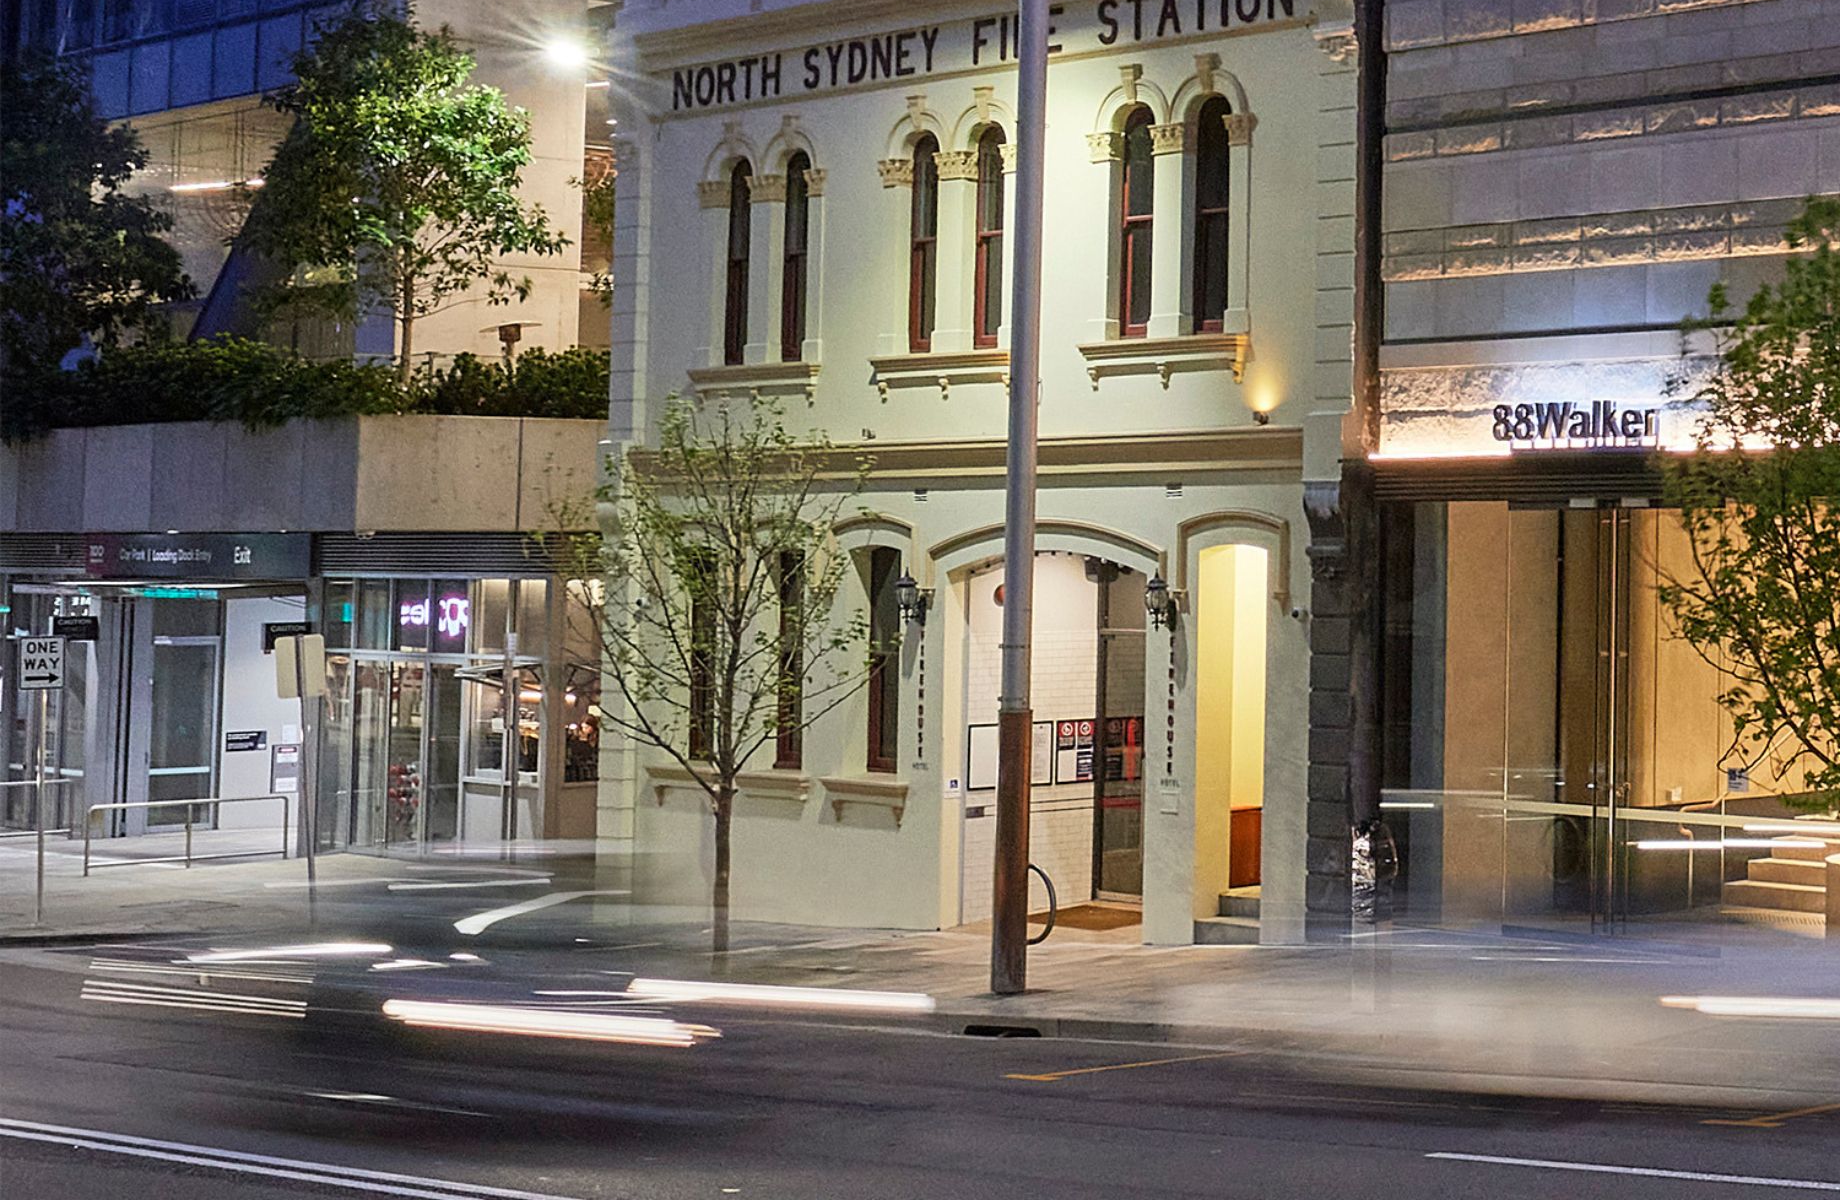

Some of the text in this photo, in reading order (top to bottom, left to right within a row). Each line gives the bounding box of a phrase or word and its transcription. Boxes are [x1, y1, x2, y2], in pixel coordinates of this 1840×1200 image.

[672, 53, 782, 110] NORTH
[803, 26, 940, 90] SYDNEY
[1492, 400, 1660, 441] 88Walker
[234, 546, 251, 563] Exit
[270, 624, 307, 633] CAUTION
[26, 641, 58, 654] ONE
[24, 658, 60, 670] WAY
